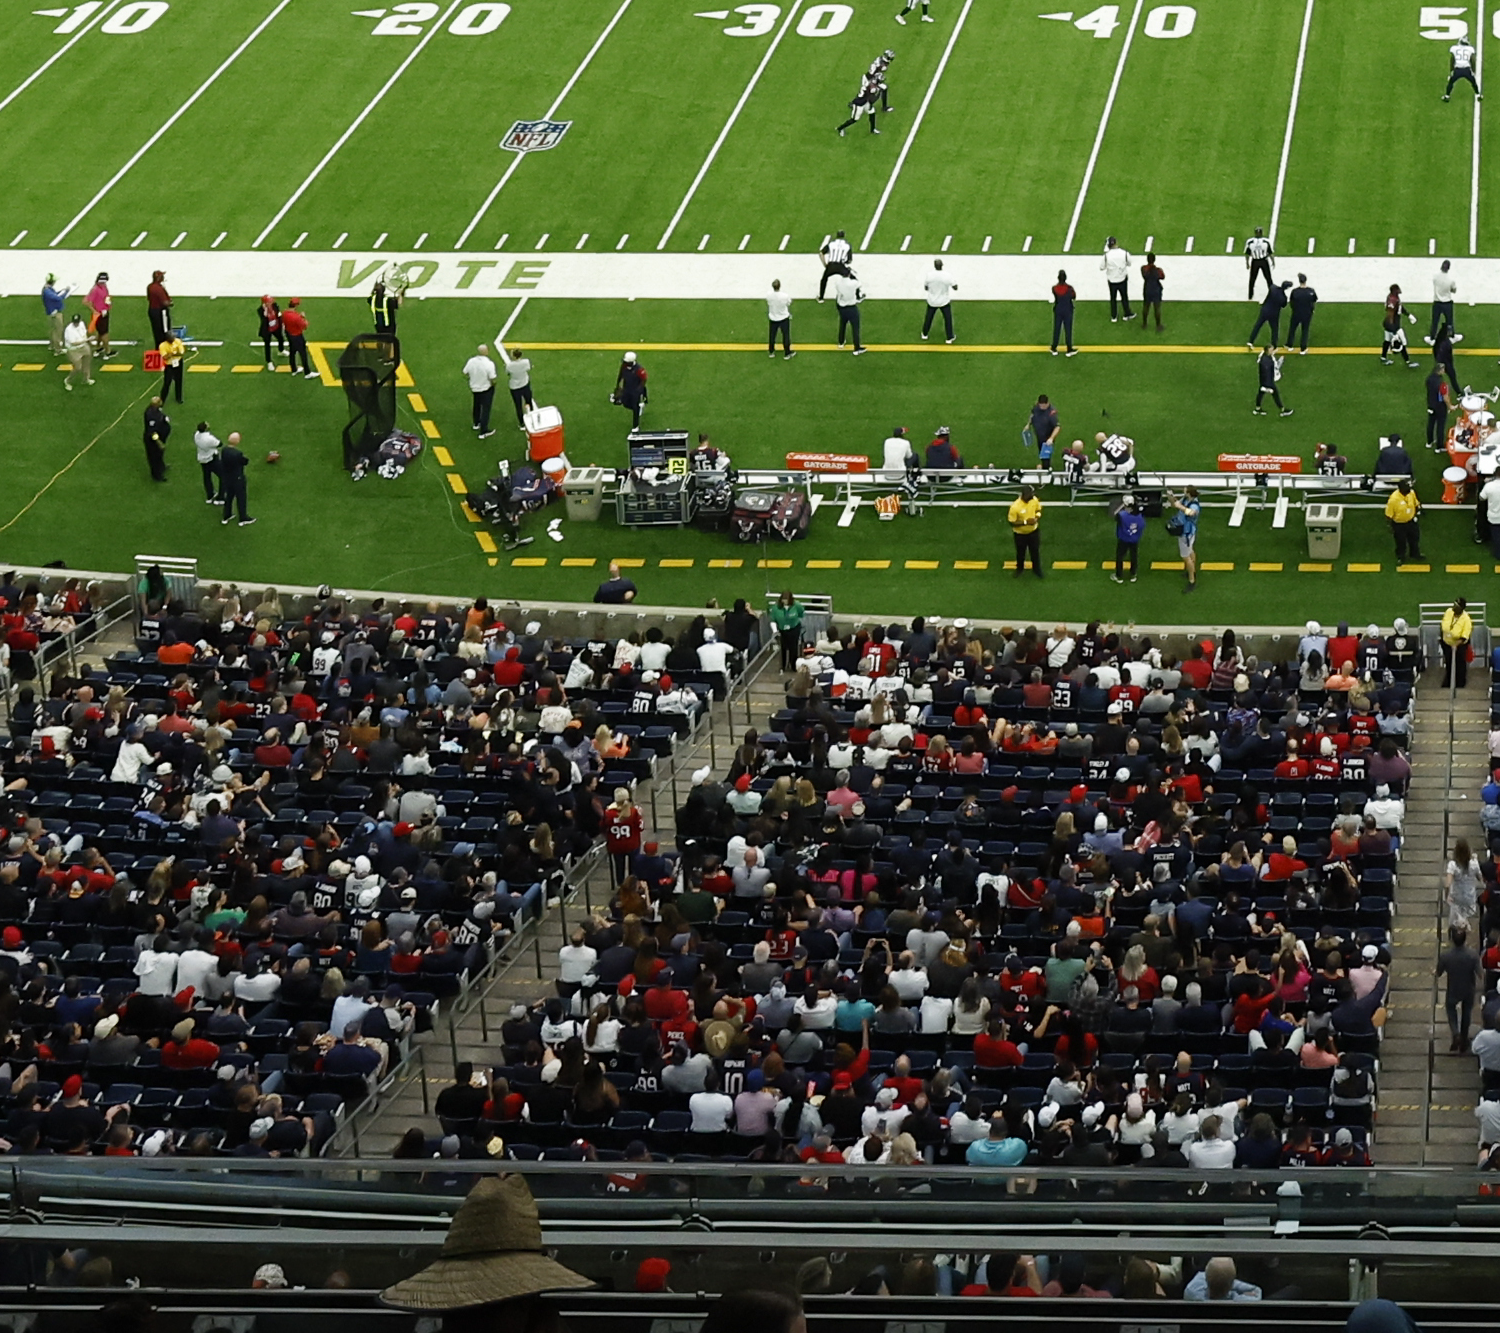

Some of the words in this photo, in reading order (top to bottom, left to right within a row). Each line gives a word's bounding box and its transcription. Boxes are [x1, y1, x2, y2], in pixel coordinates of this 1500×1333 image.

[52, 0, 170, 35] 10
[369, 1, 513, 37] 20
[723, 2, 855, 38] 30
[1072, 4, 1197, 41] 40
[508, 132, 551, 147] NFL
